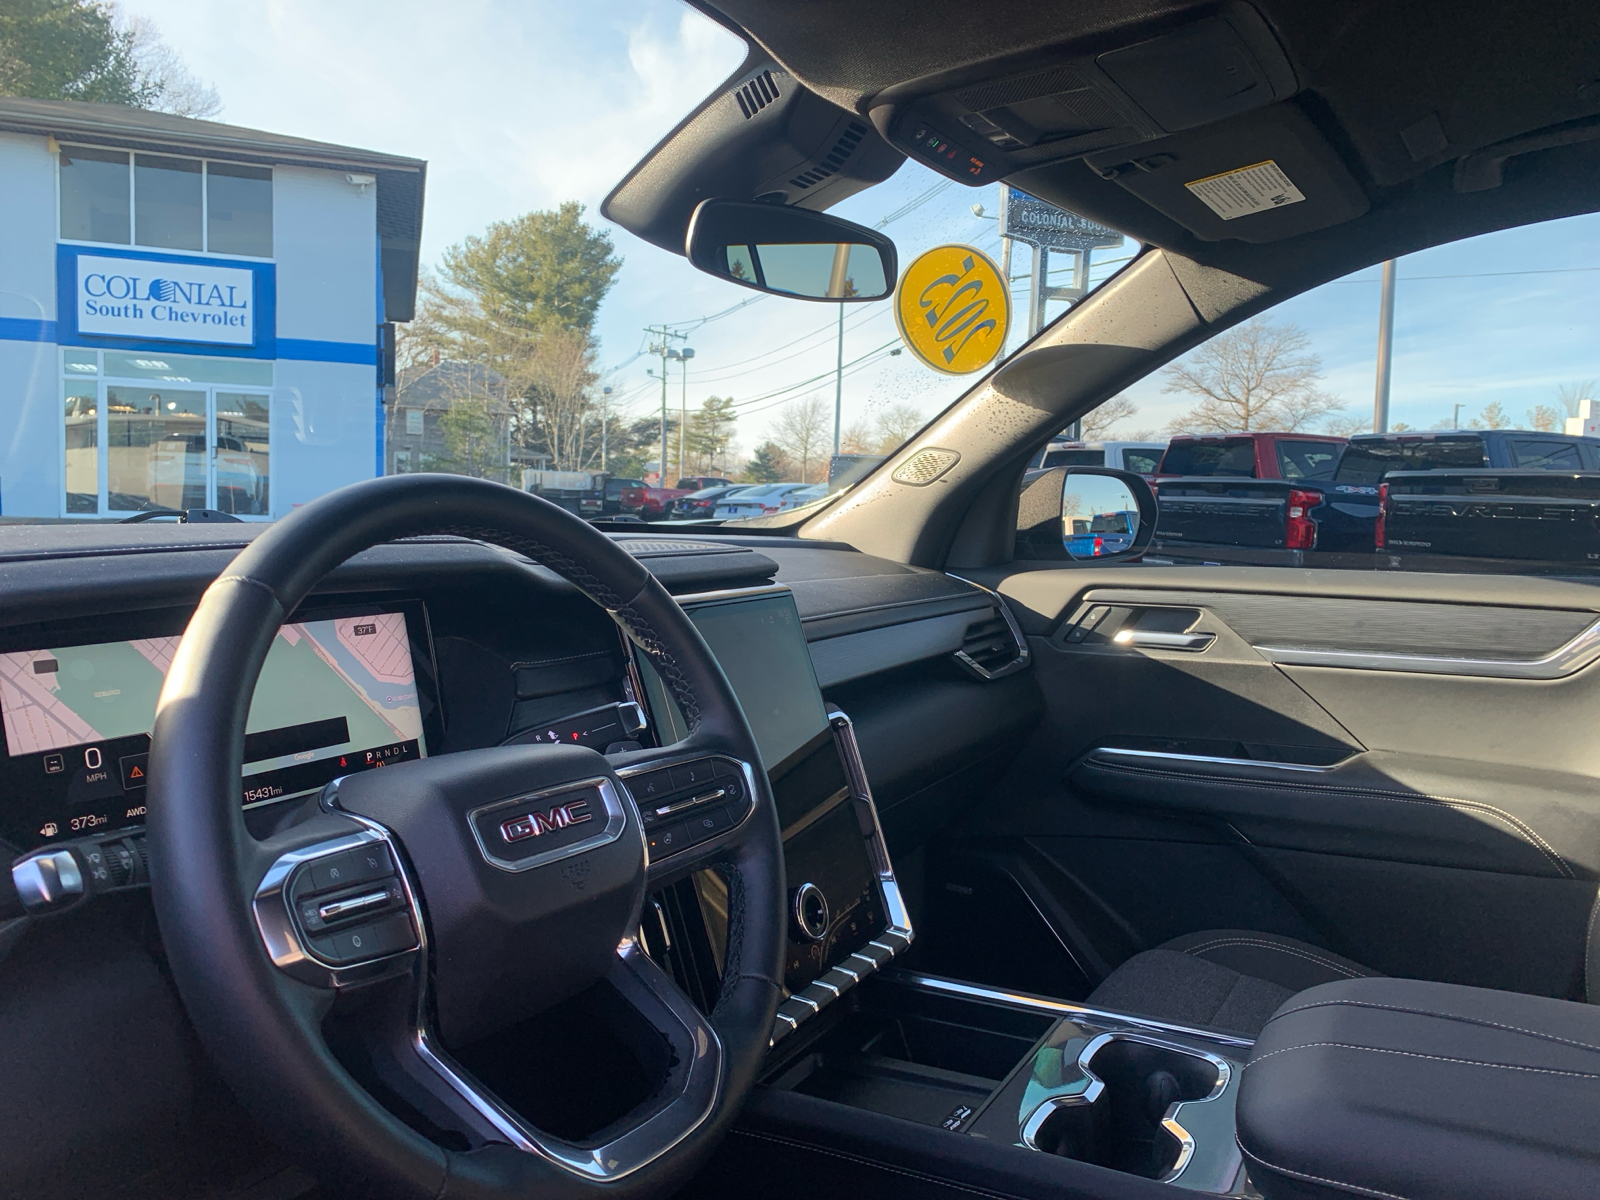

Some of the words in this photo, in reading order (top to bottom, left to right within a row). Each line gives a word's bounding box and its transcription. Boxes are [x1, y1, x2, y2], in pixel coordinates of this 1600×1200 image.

[1021, 211, 1073, 228] COLONIAL
[84, 273, 247, 309] COLONIAL
[85, 299, 144, 319] South
[151, 305, 247, 327] Chevrolet
[85, 747, 102, 769] 0
[366, 751, 373, 762] P
[375, 750, 382, 759] R
[384, 749, 391, 757] N
[393, 746, 400, 755] D
[402, 745, 408, 753] L
[86, 771, 107, 783] MPH
[126, 806, 147, 818] AWD
[500, 800, 592, 843] GMC
